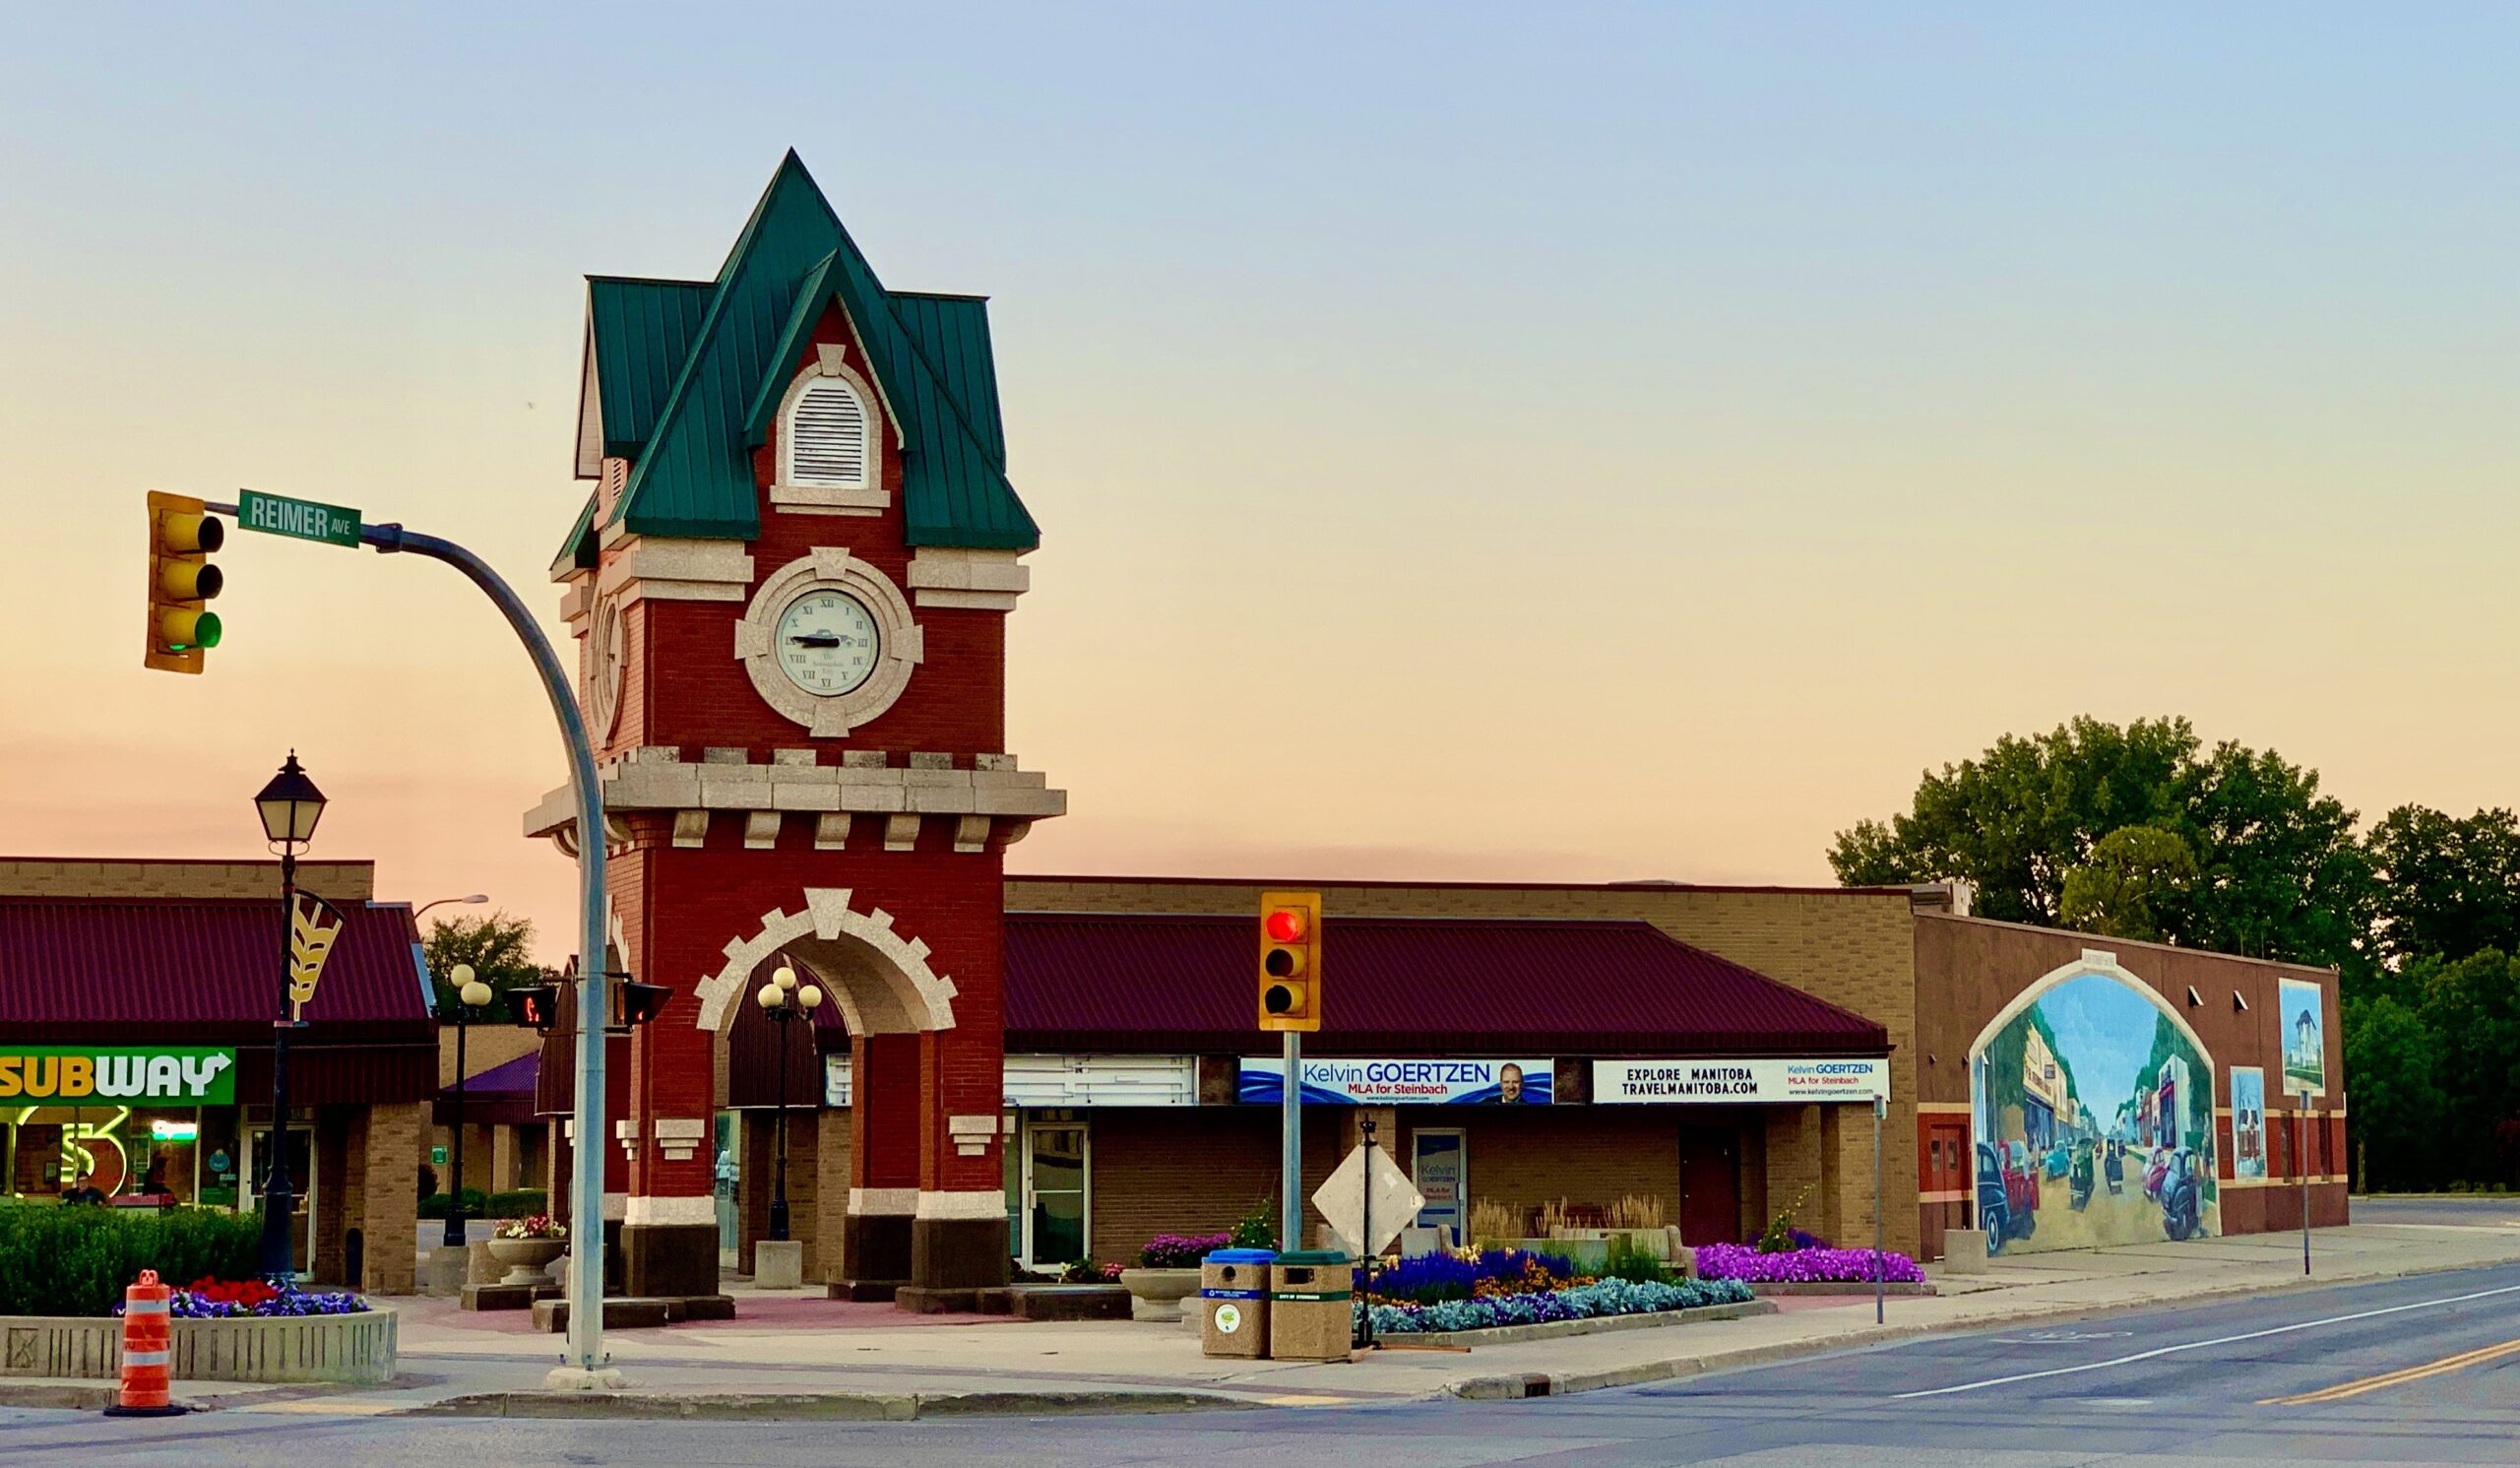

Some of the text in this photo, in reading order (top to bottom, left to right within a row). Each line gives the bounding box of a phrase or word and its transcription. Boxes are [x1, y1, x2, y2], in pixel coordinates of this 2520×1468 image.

[251, 496, 350, 538] REIMER AVE
[0, 1053, 231, 1098] SUBWAY
[1304, 1063, 1490, 1083] Kelvin GOERTZEN
[1627, 1068, 1752, 1081] EXPLORE MANITOBA
[1788, 1064, 1873, 1074] Kelvin GOERTZEN
[1348, 1083, 1448, 1095] MLA for Steinbach
[1622, 1082, 1758, 1095] TRAVELMANITOBA.COM
